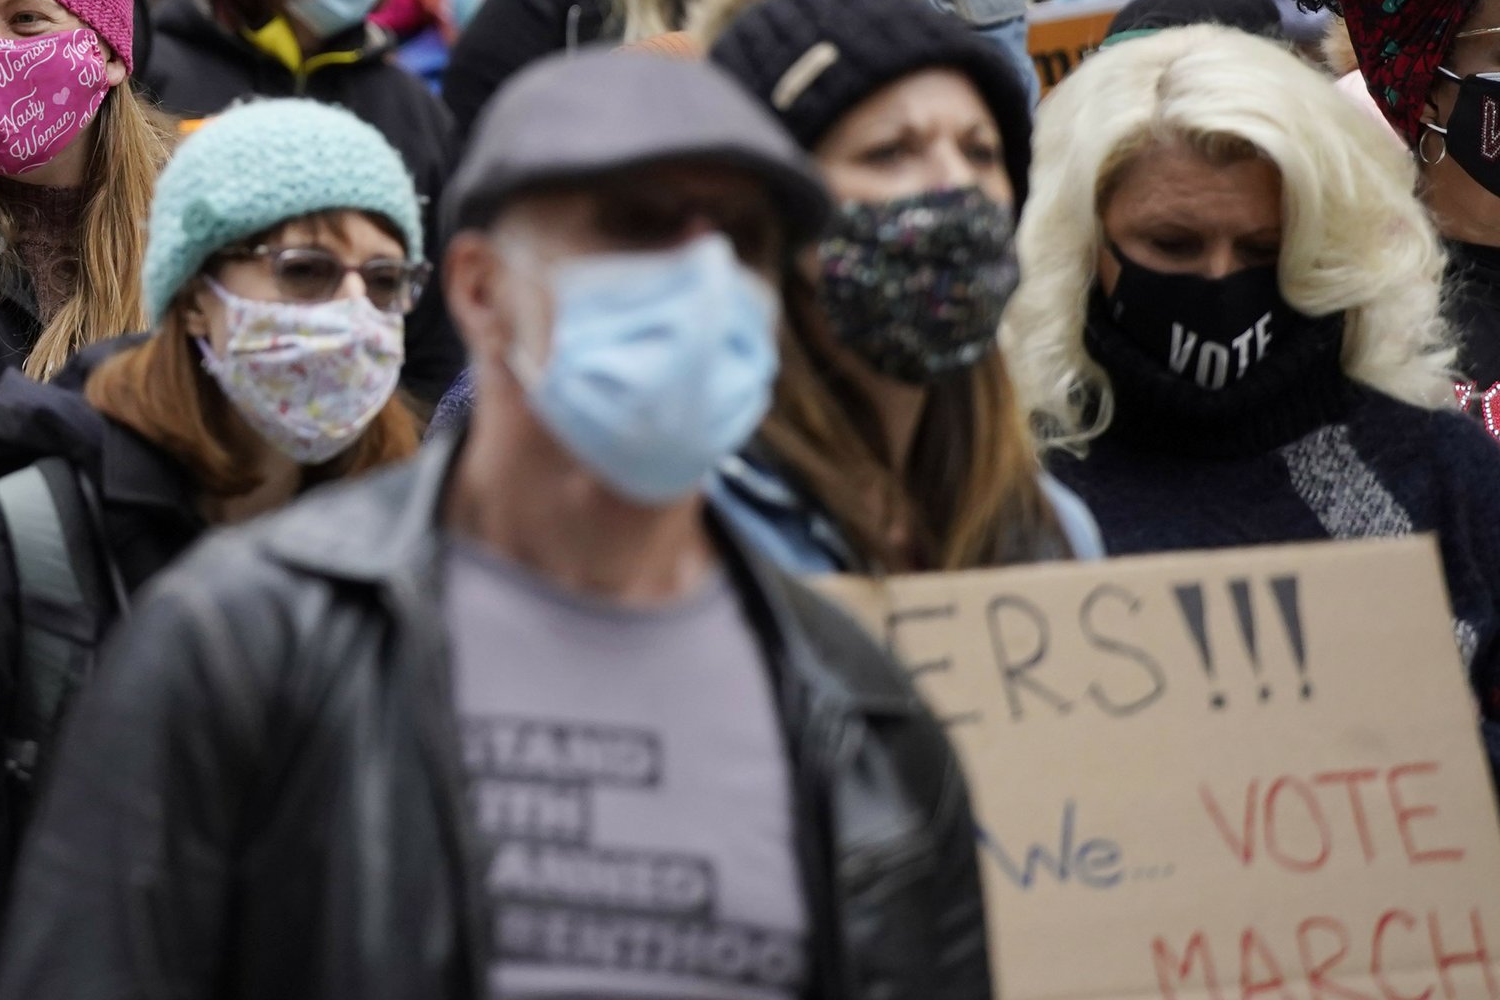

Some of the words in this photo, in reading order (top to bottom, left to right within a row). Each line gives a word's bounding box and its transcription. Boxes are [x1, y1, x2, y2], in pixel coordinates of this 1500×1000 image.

[10, 111, 76, 161] Woman
[1168, 311, 1273, 390] VOTE
[476, 786, 580, 836] ITH
[1200, 761, 1466, 875] VOTE
[484, 850, 706, 908] ANNED
[1150, 908, 1500, 1000] MARCH
